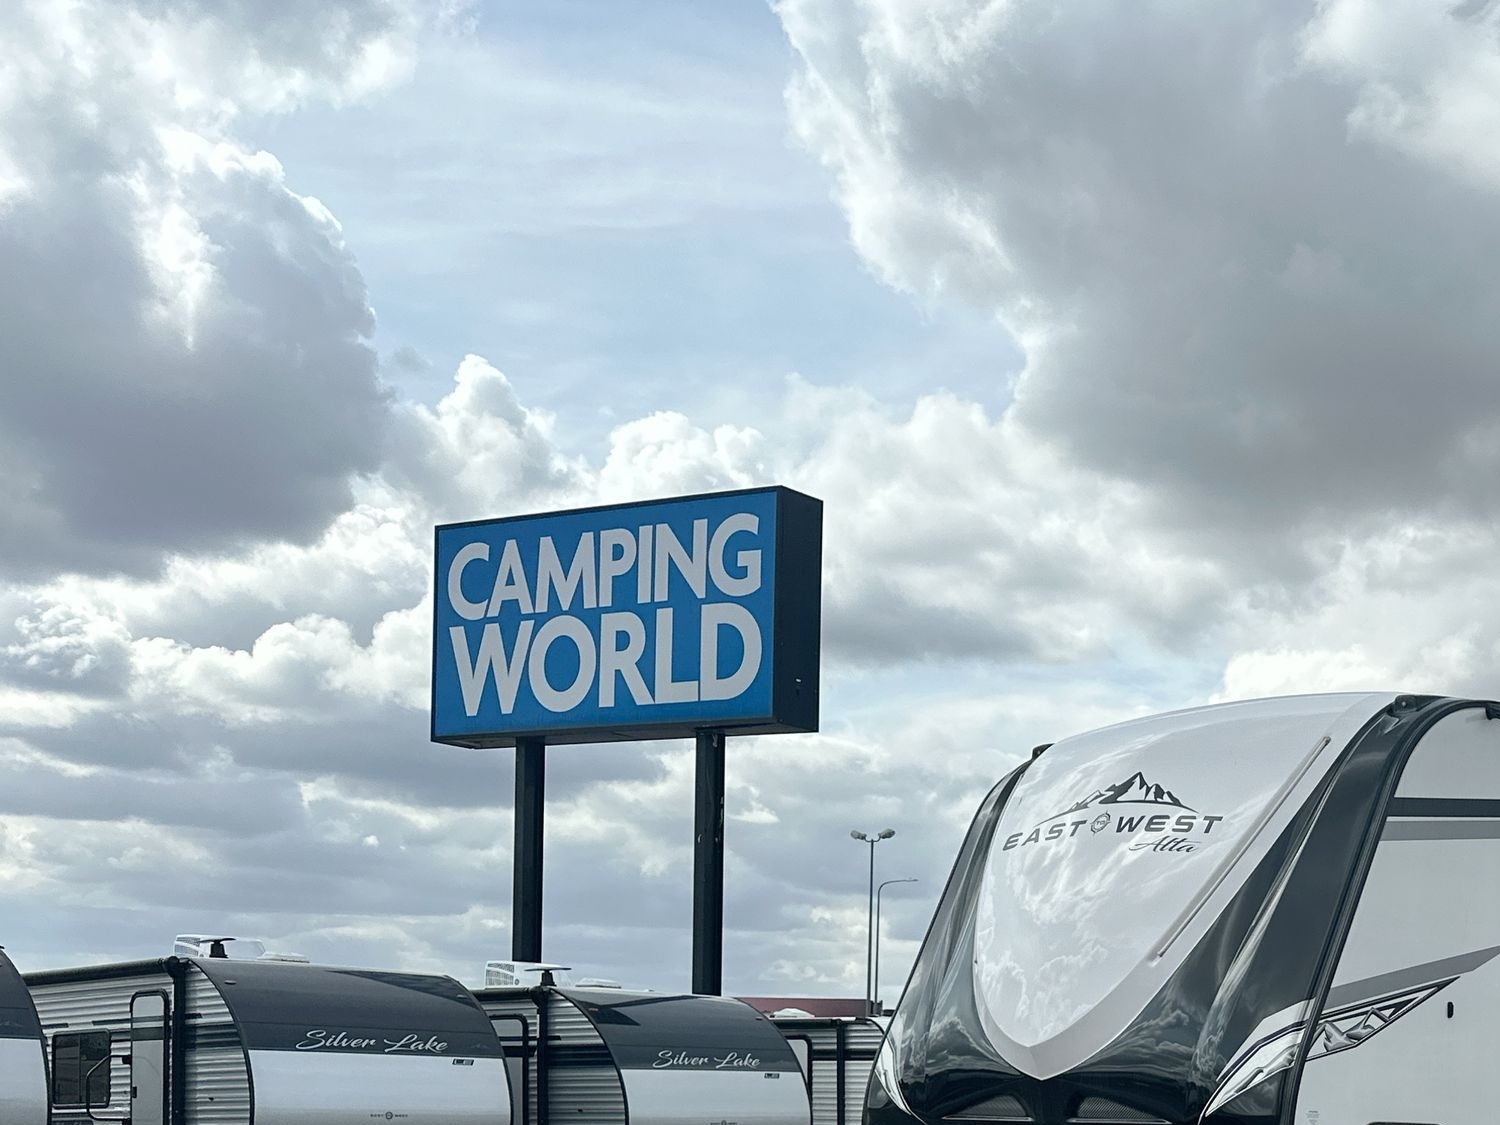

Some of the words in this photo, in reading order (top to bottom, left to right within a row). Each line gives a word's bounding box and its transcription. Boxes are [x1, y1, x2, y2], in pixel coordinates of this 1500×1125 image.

[447, 512, 762, 621] CAMPING
[449, 602, 762, 717] WORLD
[1002, 819, 1087, 851] EAST
[1116, 814, 1224, 834] WEST
[1129, 835, 1201, 853] Alta
[296, 1030, 376, 1050] Silver
[384, 1034, 448, 1053] Lake
[652, 1050, 708, 1069] Silver
[714, 1052, 761, 1069] Lake
